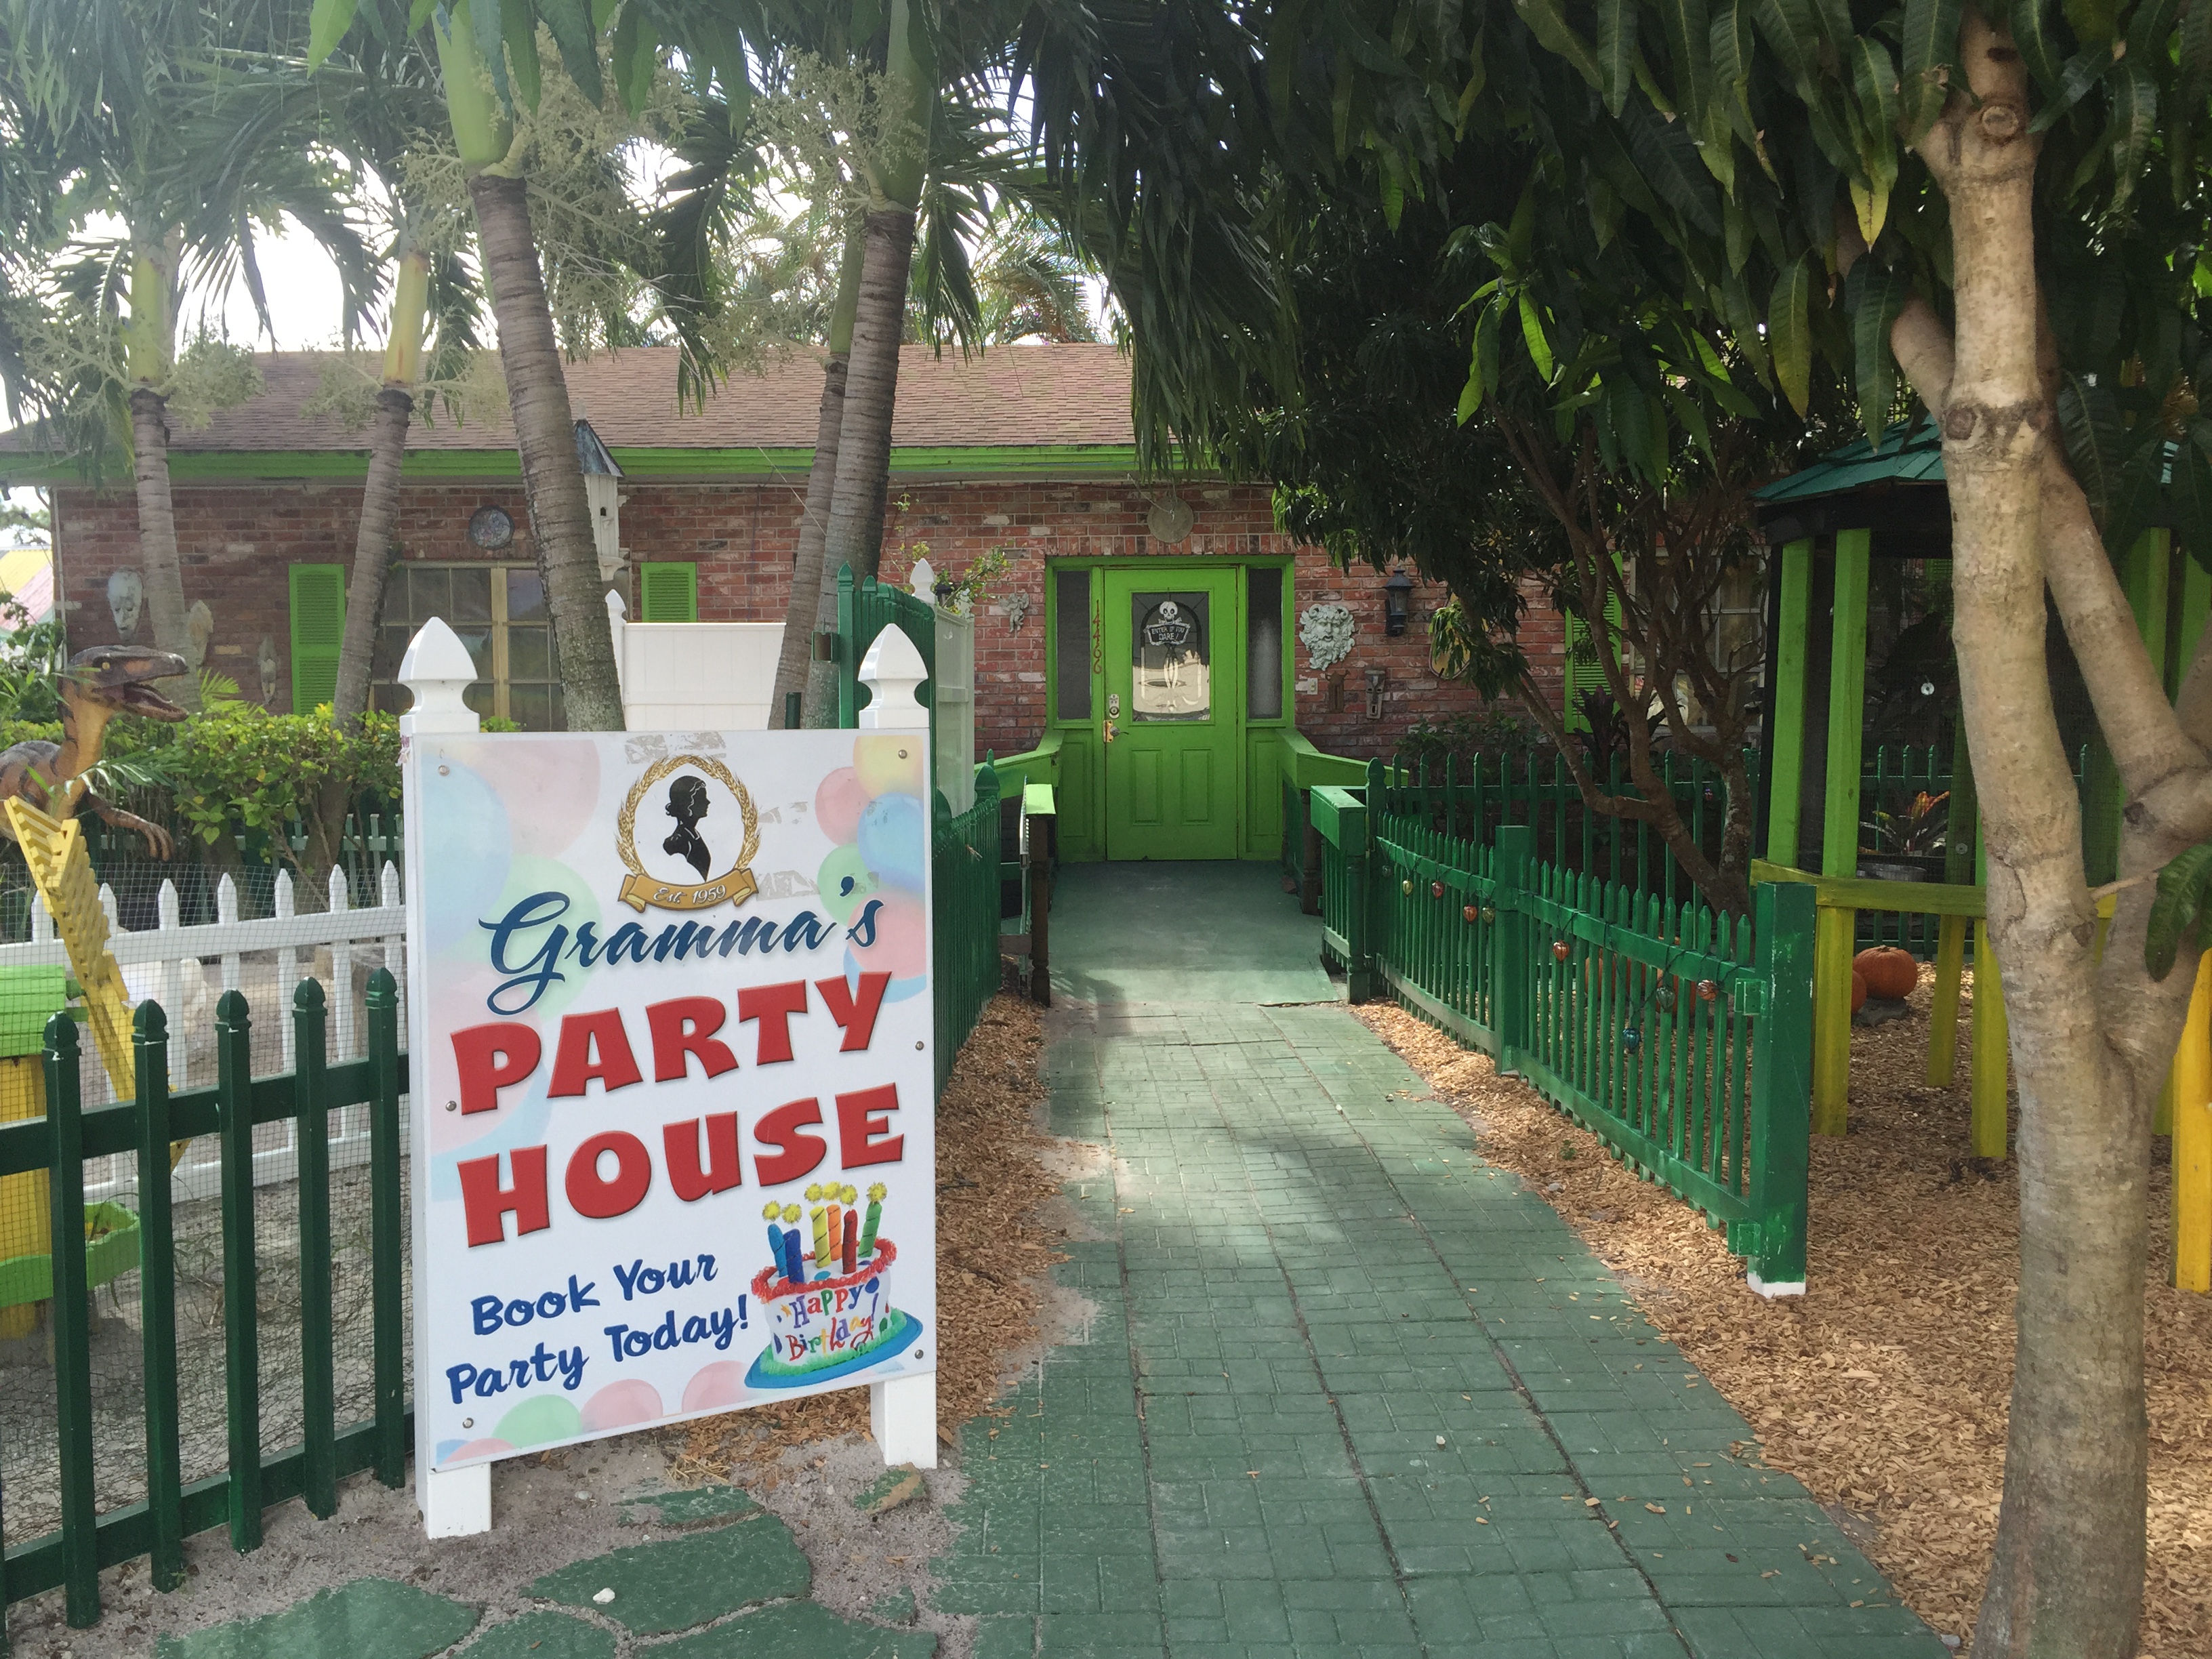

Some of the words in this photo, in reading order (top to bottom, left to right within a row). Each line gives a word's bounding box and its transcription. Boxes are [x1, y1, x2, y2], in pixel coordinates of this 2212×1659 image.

[1092, 599, 1103, 675] 14466
[1151, 626, 1168, 635] ENTER
[653, 887, 687, 903] Est.
[693, 884, 726, 903] 1959
[478, 876, 884, 1016] Gramma's
[449, 970, 893, 1116] PARTY
[456, 1082, 905, 1248] HOUSE
[471, 1274, 600, 1336] Book
[613, 1254, 718, 1300] Your
[788, 1284, 864, 1328] Happy
[446, 1346, 590, 1404] Party
[604, 1294, 748, 1361] Today!
